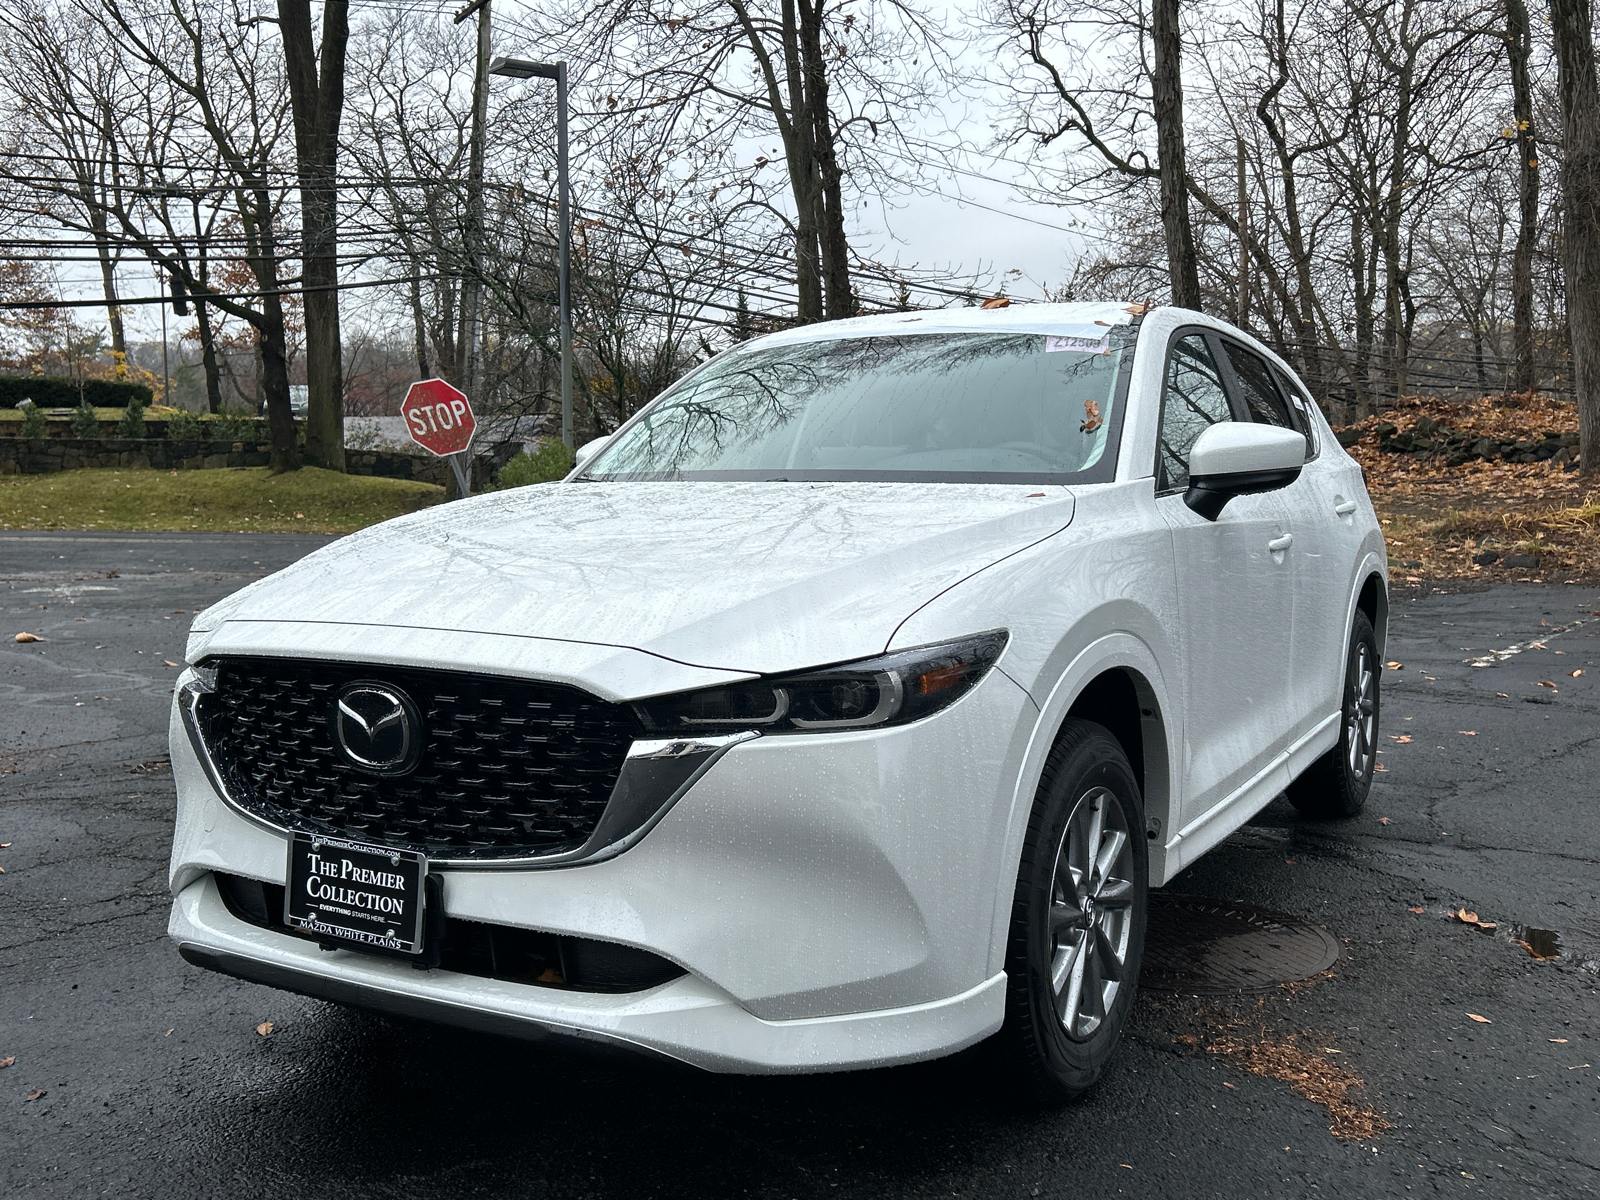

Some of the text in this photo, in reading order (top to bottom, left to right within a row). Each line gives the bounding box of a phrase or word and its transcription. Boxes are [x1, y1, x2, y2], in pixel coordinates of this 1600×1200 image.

[408, 399, 466, 436] STOP
[307, 852, 406, 891] THE PREMIER
[306, 875, 404, 915] COLLECTION
[319, 903, 351, 916] EVERYTHING
[351, 909, 370, 920] STARTS
[299, 920, 402, 949] MAZDA WHITE PLAINS
